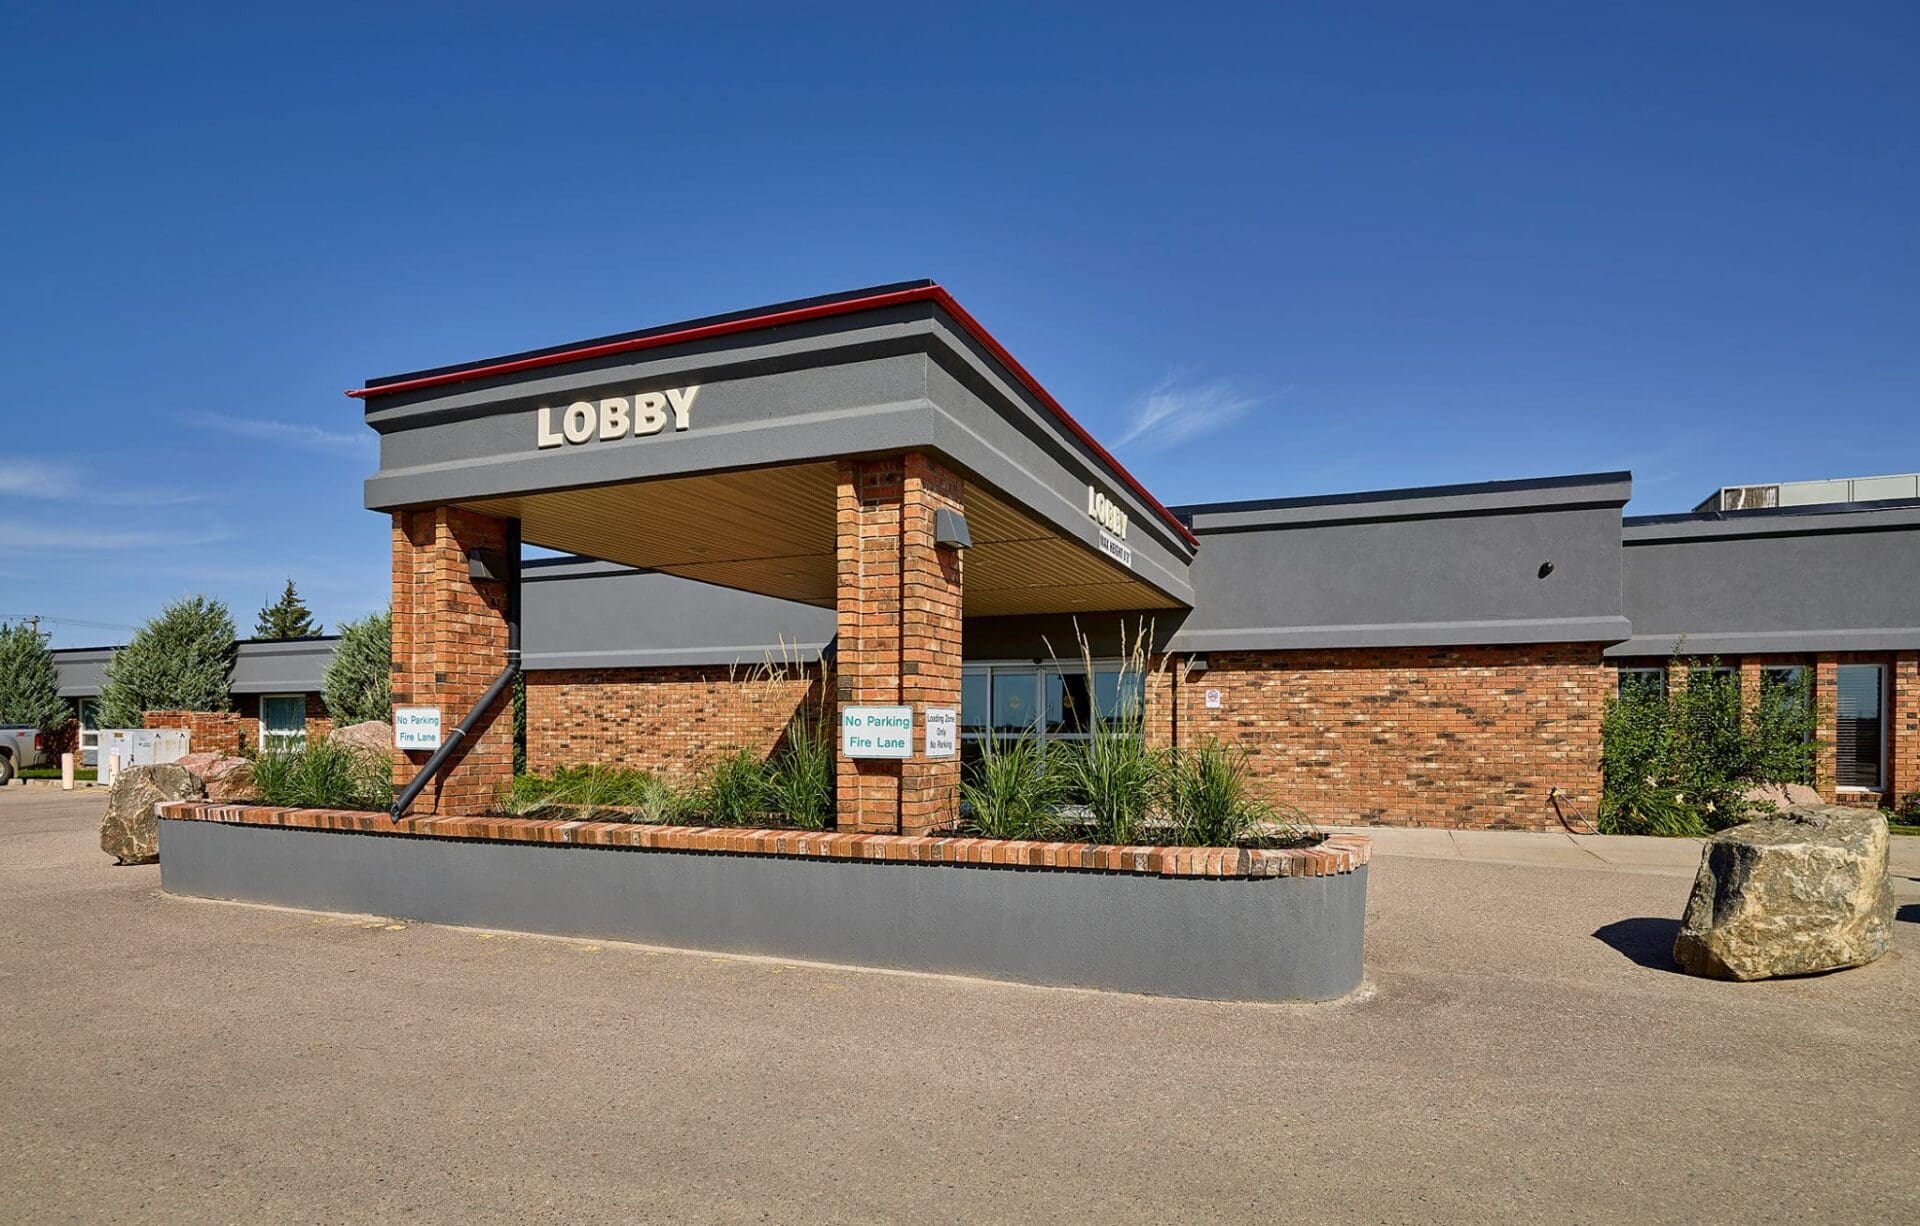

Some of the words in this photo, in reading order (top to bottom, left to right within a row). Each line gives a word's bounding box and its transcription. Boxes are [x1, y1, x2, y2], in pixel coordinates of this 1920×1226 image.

[538, 385, 701, 449] LOBBY
[1088, 486, 1128, 541] LOBBY
[397, 716, 408, 725] No
[411, 716, 439, 727] Parking
[845, 716, 862, 727] No
[867, 716, 910, 729] Parking
[927, 714, 944, 724] Loading
[945, 714, 955, 723] Zone
[400, 732, 415, 741] Fire
[417, 732, 436, 742] Lane
[937, 727, 946, 737] Only
[850, 737, 872, 748] Fire
[877, 737, 905, 748] Lane
[930, 741, 938, 749] No
[938, 741, 953, 750] Parking
